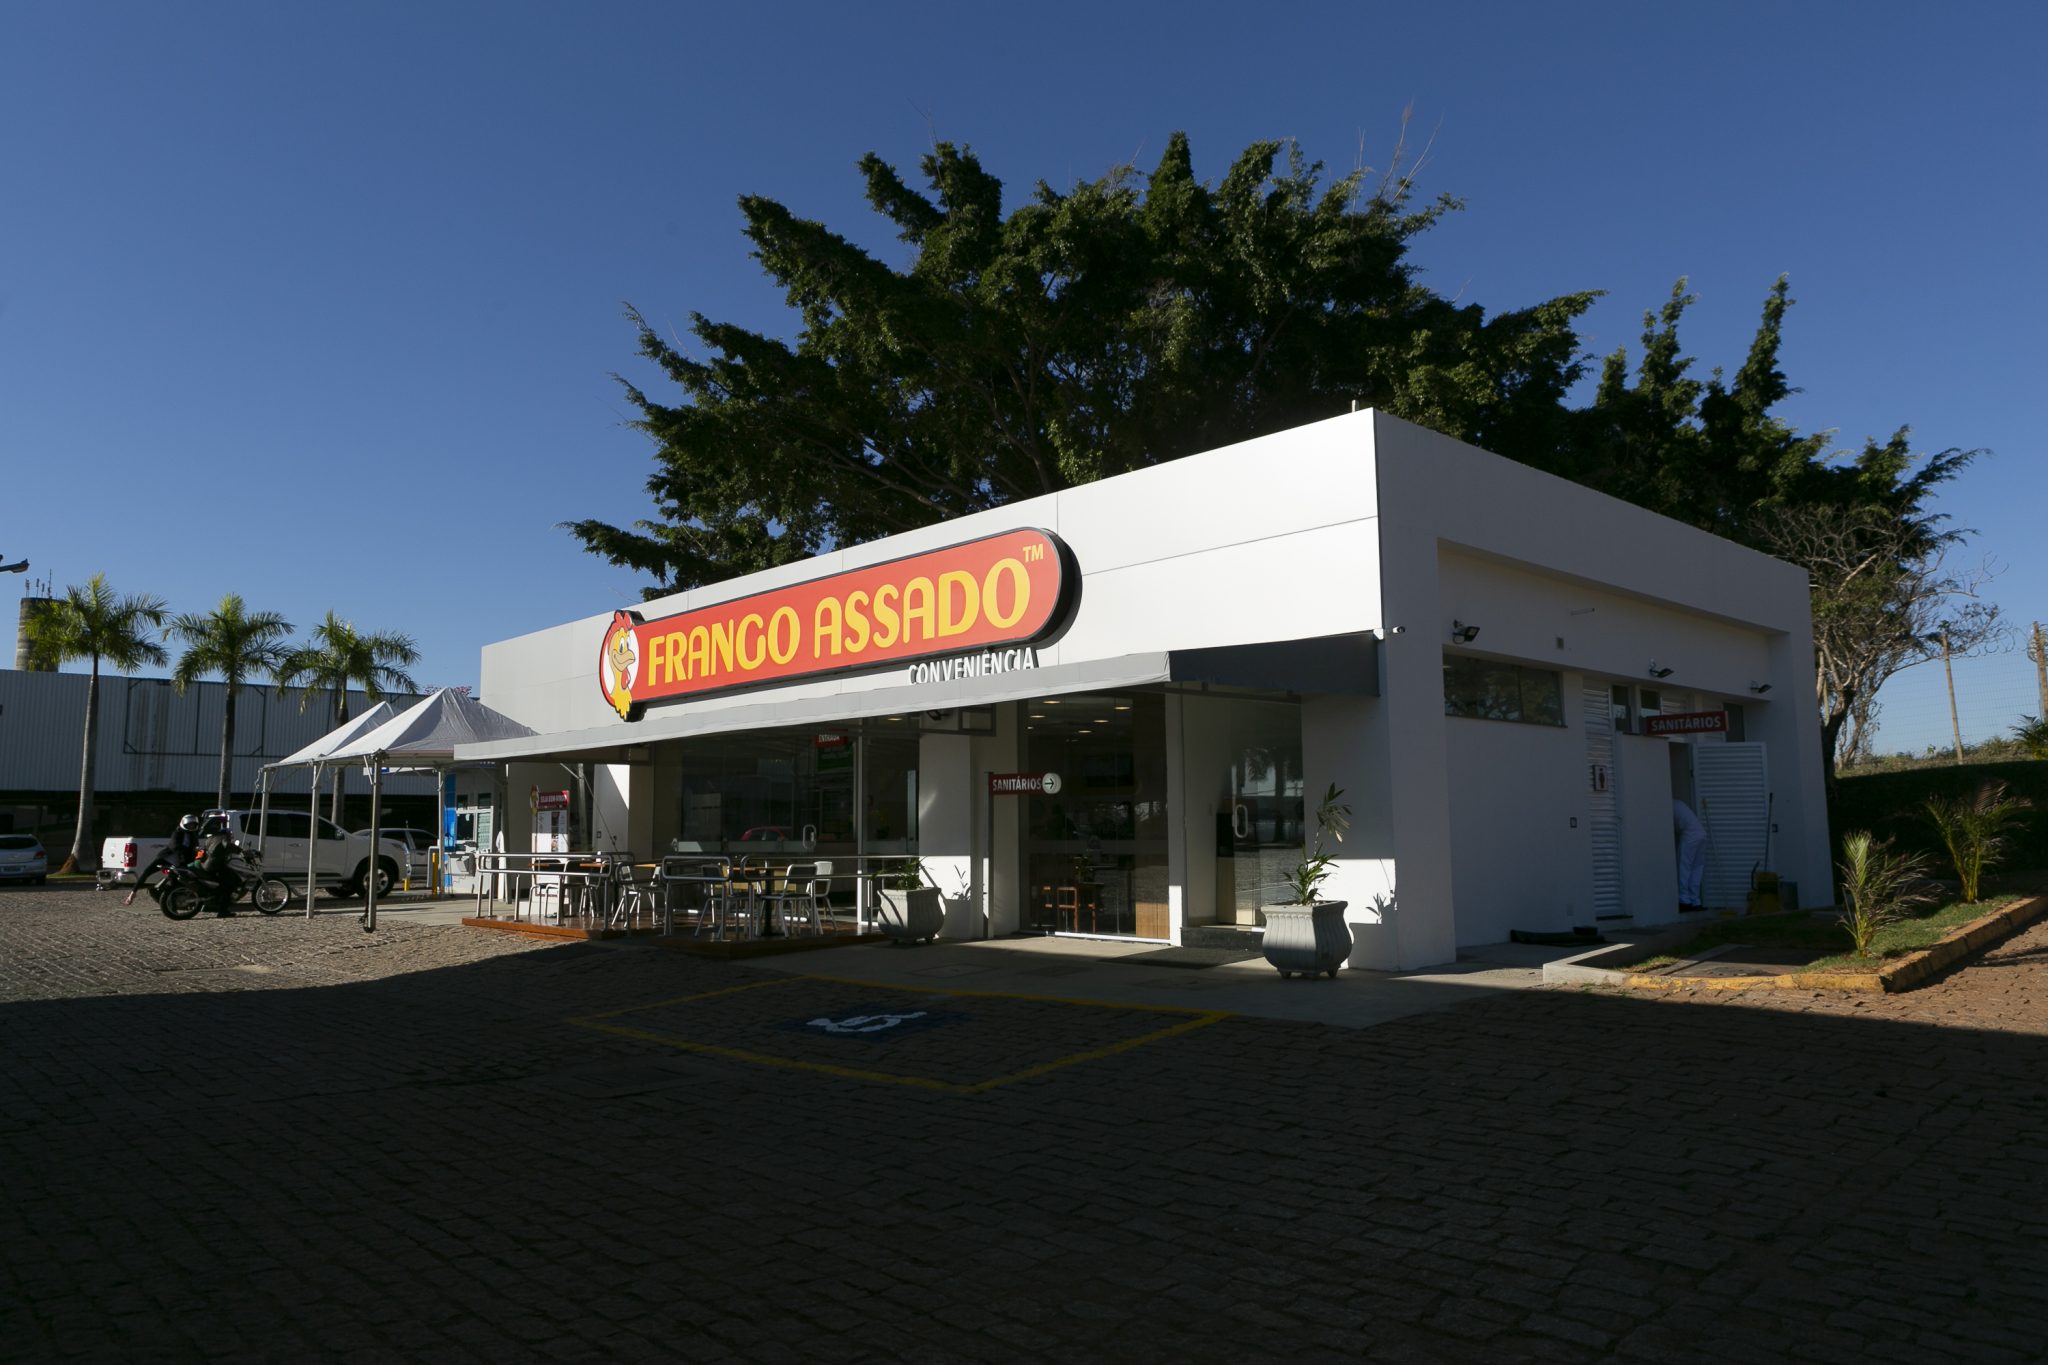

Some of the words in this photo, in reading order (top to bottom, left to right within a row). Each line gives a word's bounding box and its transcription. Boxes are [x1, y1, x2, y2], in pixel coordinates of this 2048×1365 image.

[647, 607, 801, 687] FRANGO
[814, 558, 1031, 659] ASSADO
[1022, 543, 1044, 563] TM
[908, 647, 1035, 686] CONVENIÊNCIA
[992, 776, 1042, 792] SANITÁRIOS
